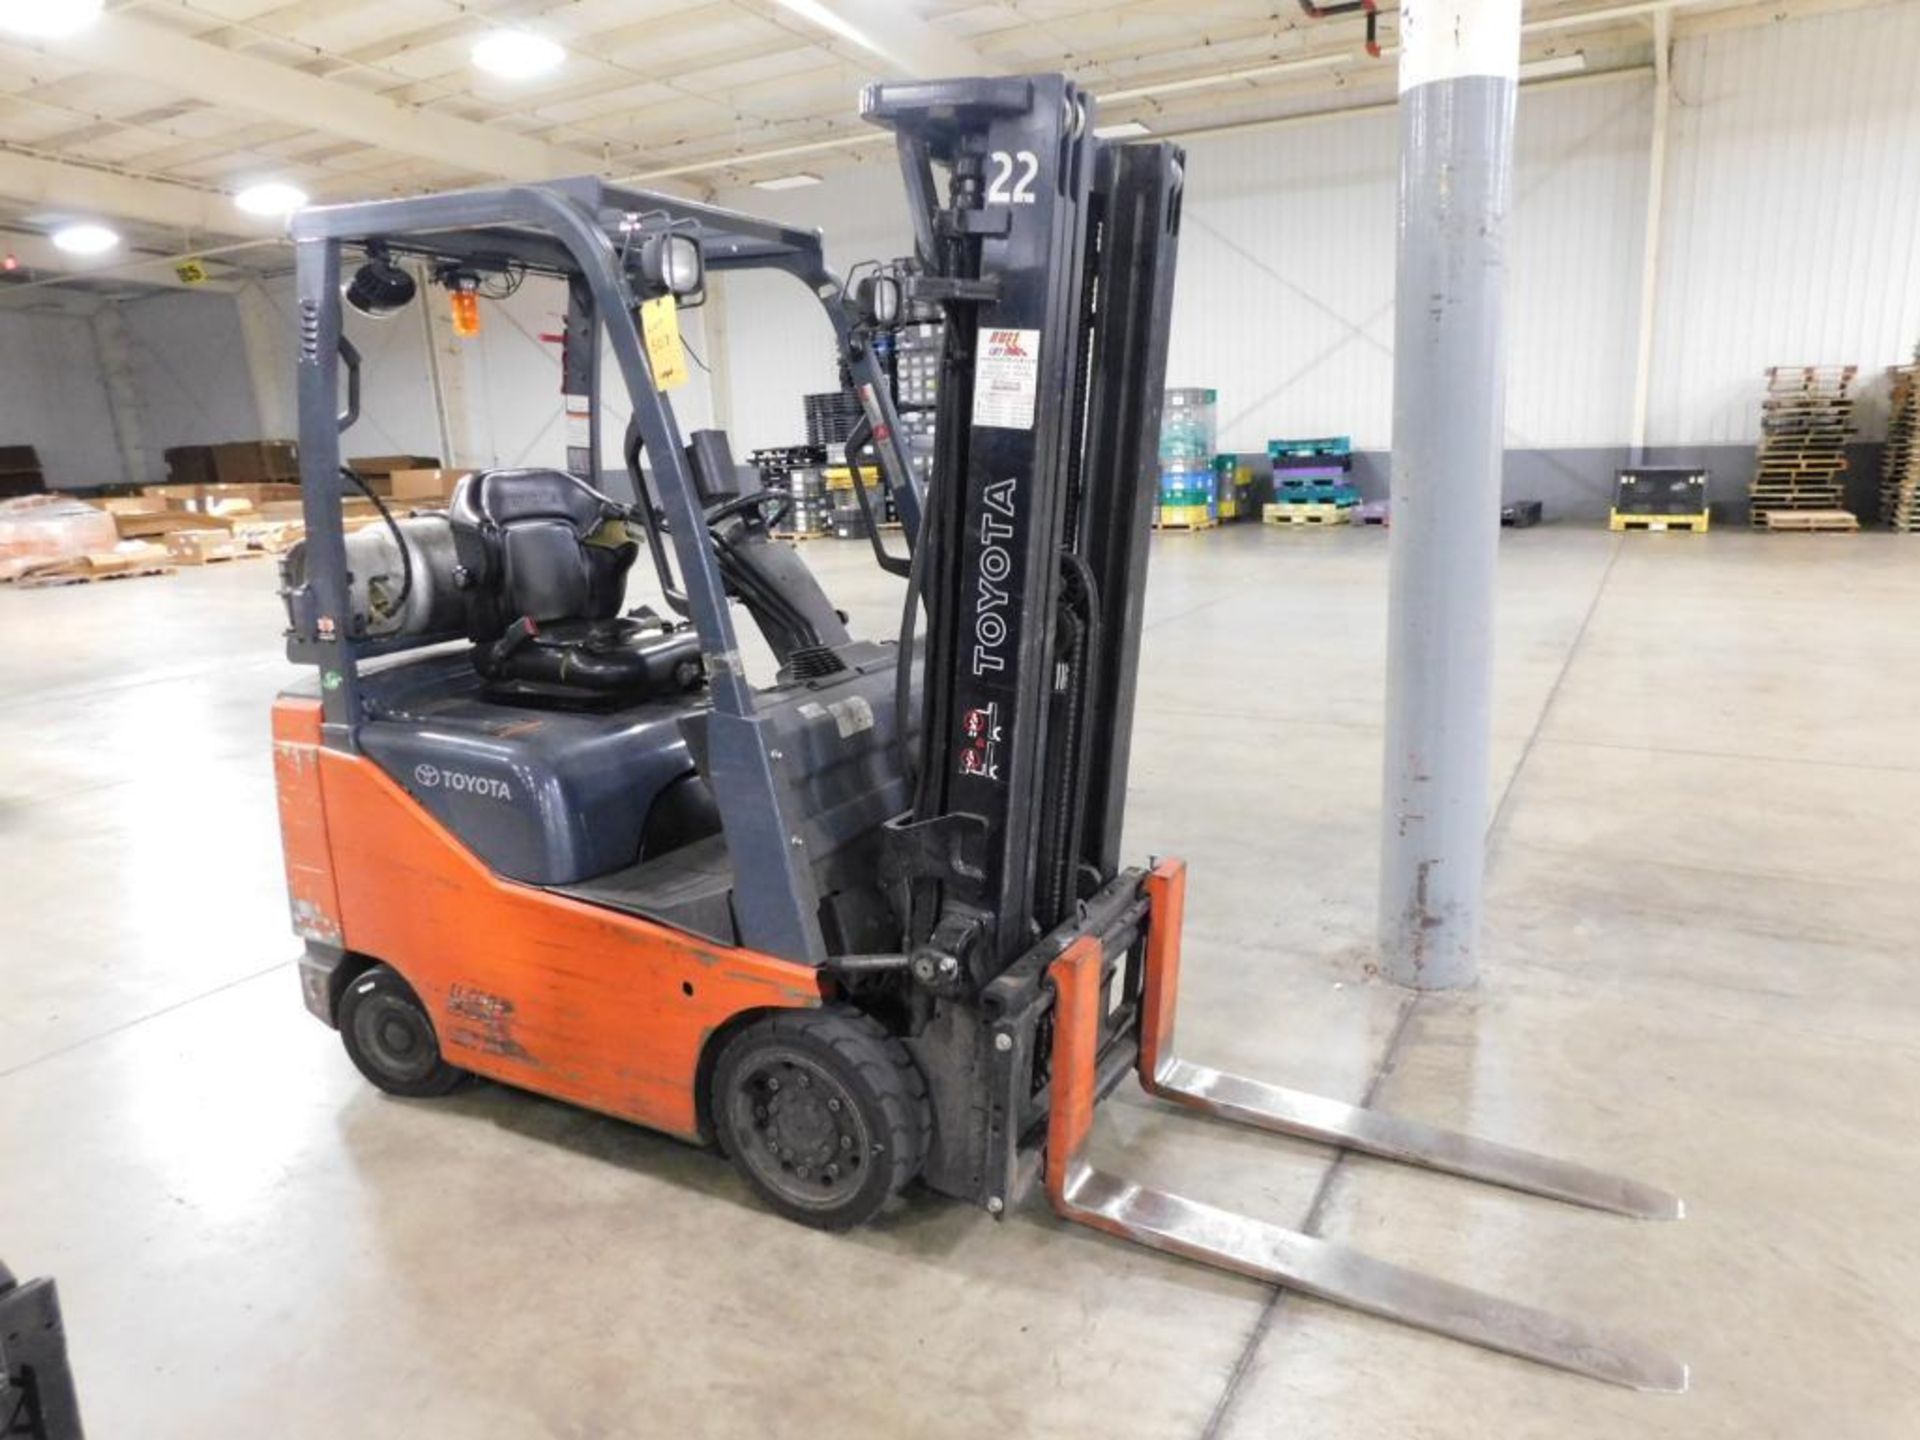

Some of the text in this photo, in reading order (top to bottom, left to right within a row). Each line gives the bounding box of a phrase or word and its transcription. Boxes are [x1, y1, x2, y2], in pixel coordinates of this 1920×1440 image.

[987, 150, 1040, 204] 22
[973, 478, 1017, 676] TOYOTA
[441, 770, 512, 802] TOYOTA
